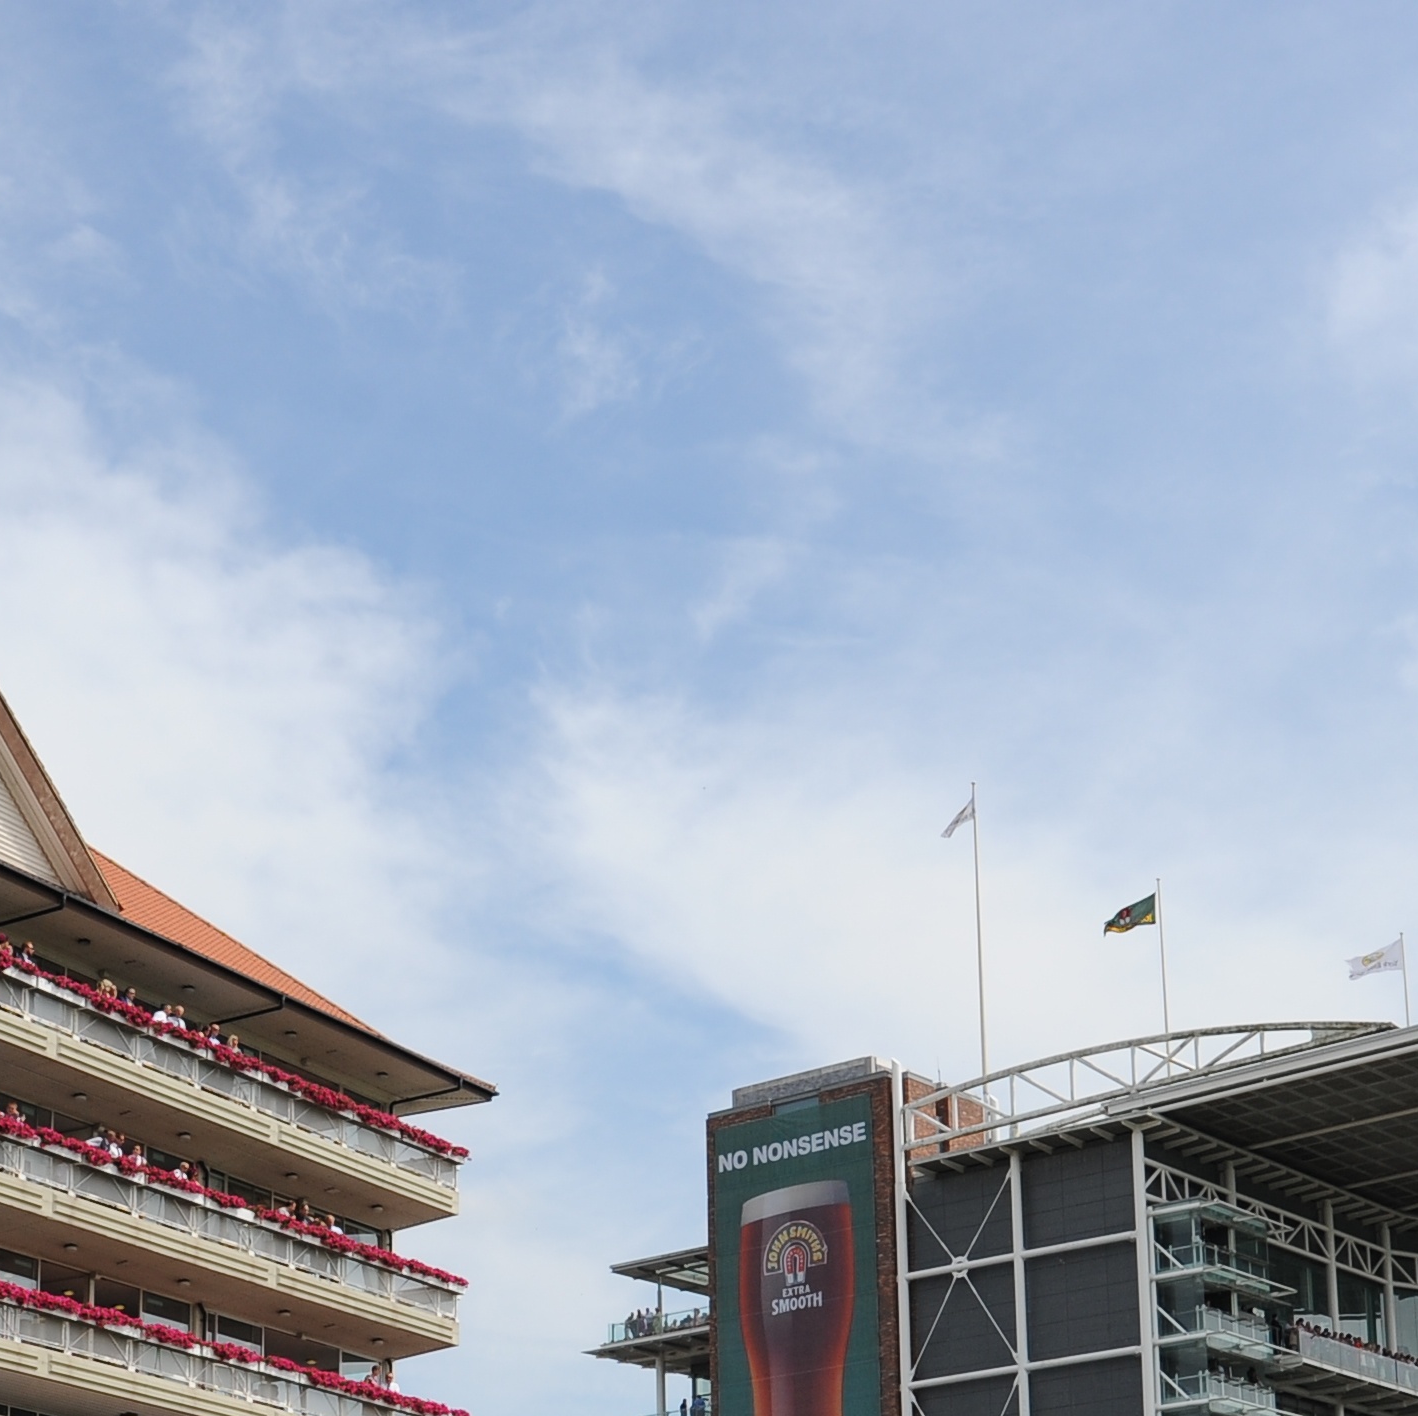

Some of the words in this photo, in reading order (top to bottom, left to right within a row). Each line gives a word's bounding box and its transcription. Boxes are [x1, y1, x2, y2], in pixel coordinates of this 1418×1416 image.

[718, 1150, 748, 1173] NO
[752, 1122, 867, 1166] NONSENSE
[767, 1230, 789, 1270] JOHN
[771, 1291, 823, 1316] SMOOTH
[782, 1284, 811, 1298] EXTRA
